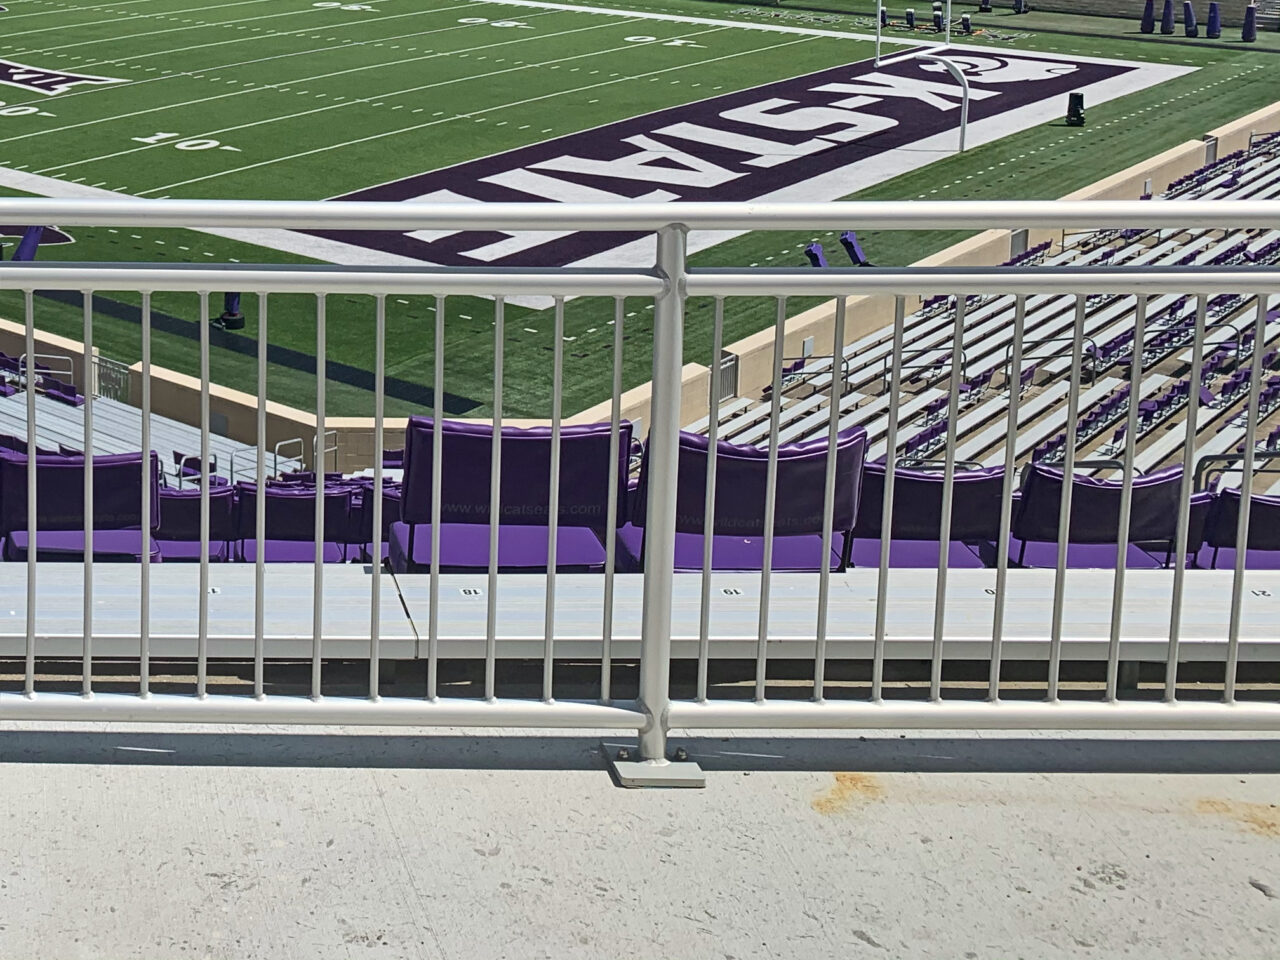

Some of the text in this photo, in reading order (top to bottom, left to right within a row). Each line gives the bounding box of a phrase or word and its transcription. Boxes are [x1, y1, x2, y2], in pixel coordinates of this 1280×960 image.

[131, 131, 221, 151] 10
[402, 71, 1002, 263] K-STATE
[462, 588, 480, 596] 18
[1250, 589, 1272, 597] 21
